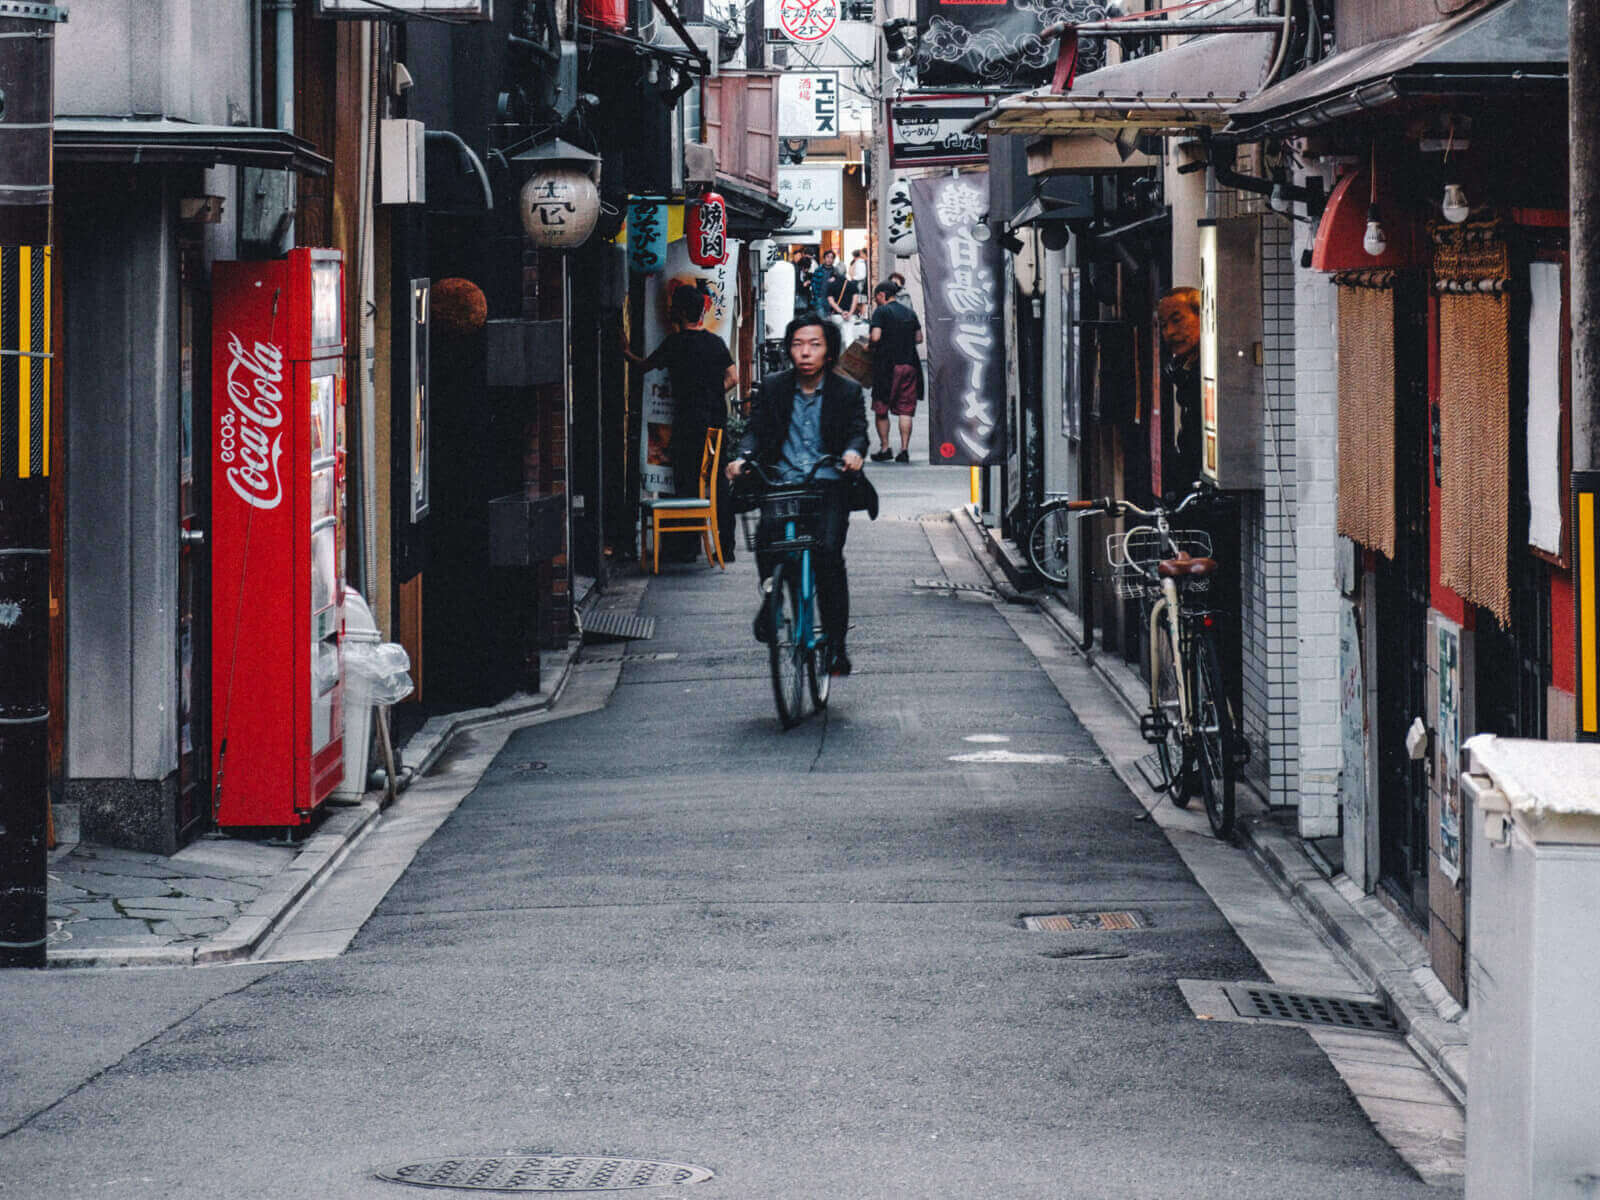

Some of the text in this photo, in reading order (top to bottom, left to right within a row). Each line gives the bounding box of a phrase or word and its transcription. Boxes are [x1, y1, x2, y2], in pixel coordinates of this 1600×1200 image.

[798, 25, 819, 35] 2F
[815, 78, 835, 132] エビス
[902, 127, 936, 138] らーめん
[699, 202, 726, 259] 焼肉
[227, 330, 284, 510] Coca-Cola
